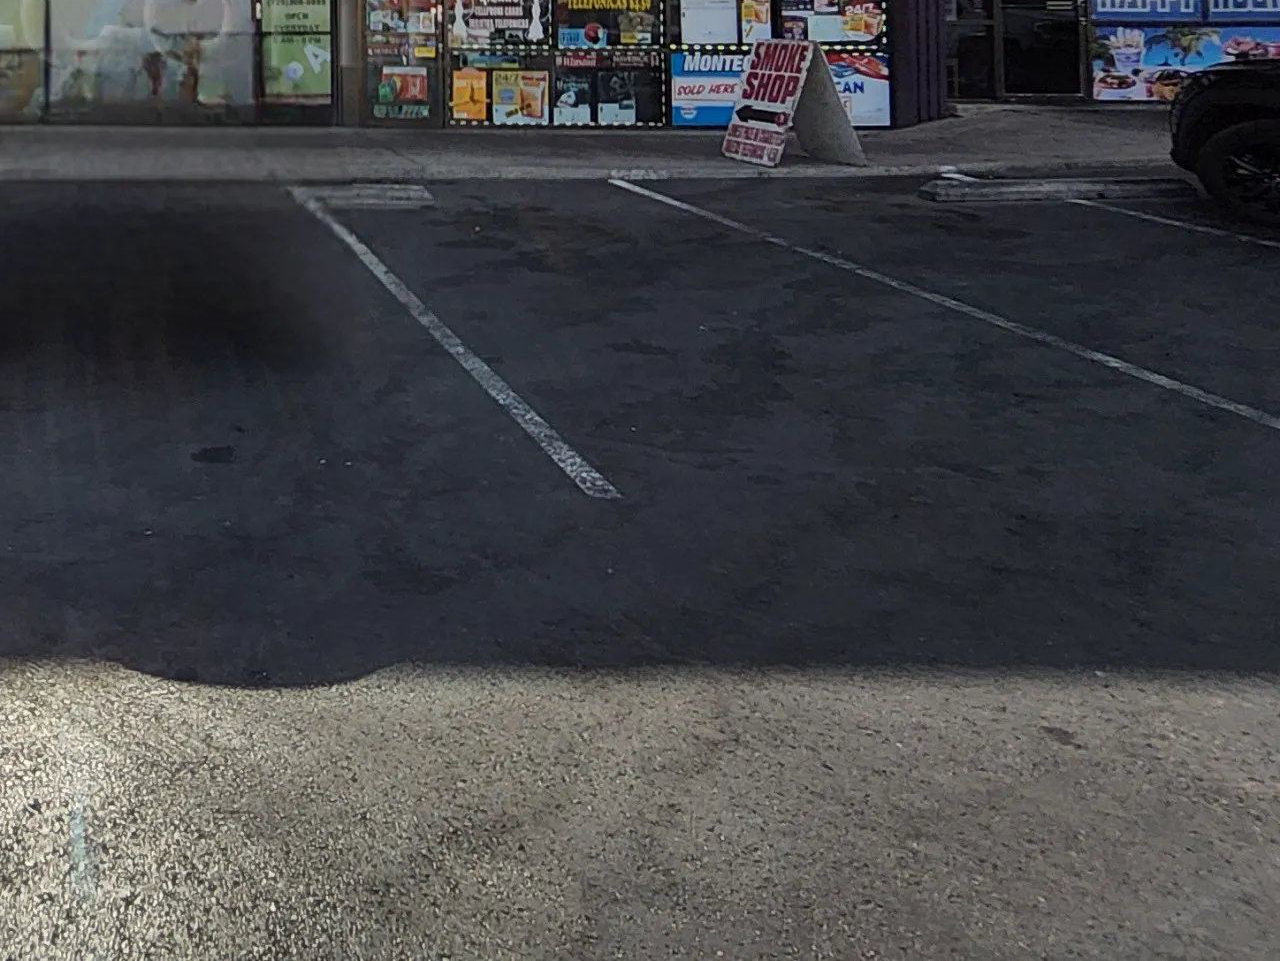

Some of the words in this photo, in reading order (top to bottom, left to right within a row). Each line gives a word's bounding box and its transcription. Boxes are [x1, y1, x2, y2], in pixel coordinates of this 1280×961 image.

[750, 42, 808, 73] SMOKE
[677, 85, 704, 96] SOLD
[708, 83, 737, 94] HERE
[742, 74, 801, 104] SHOP
